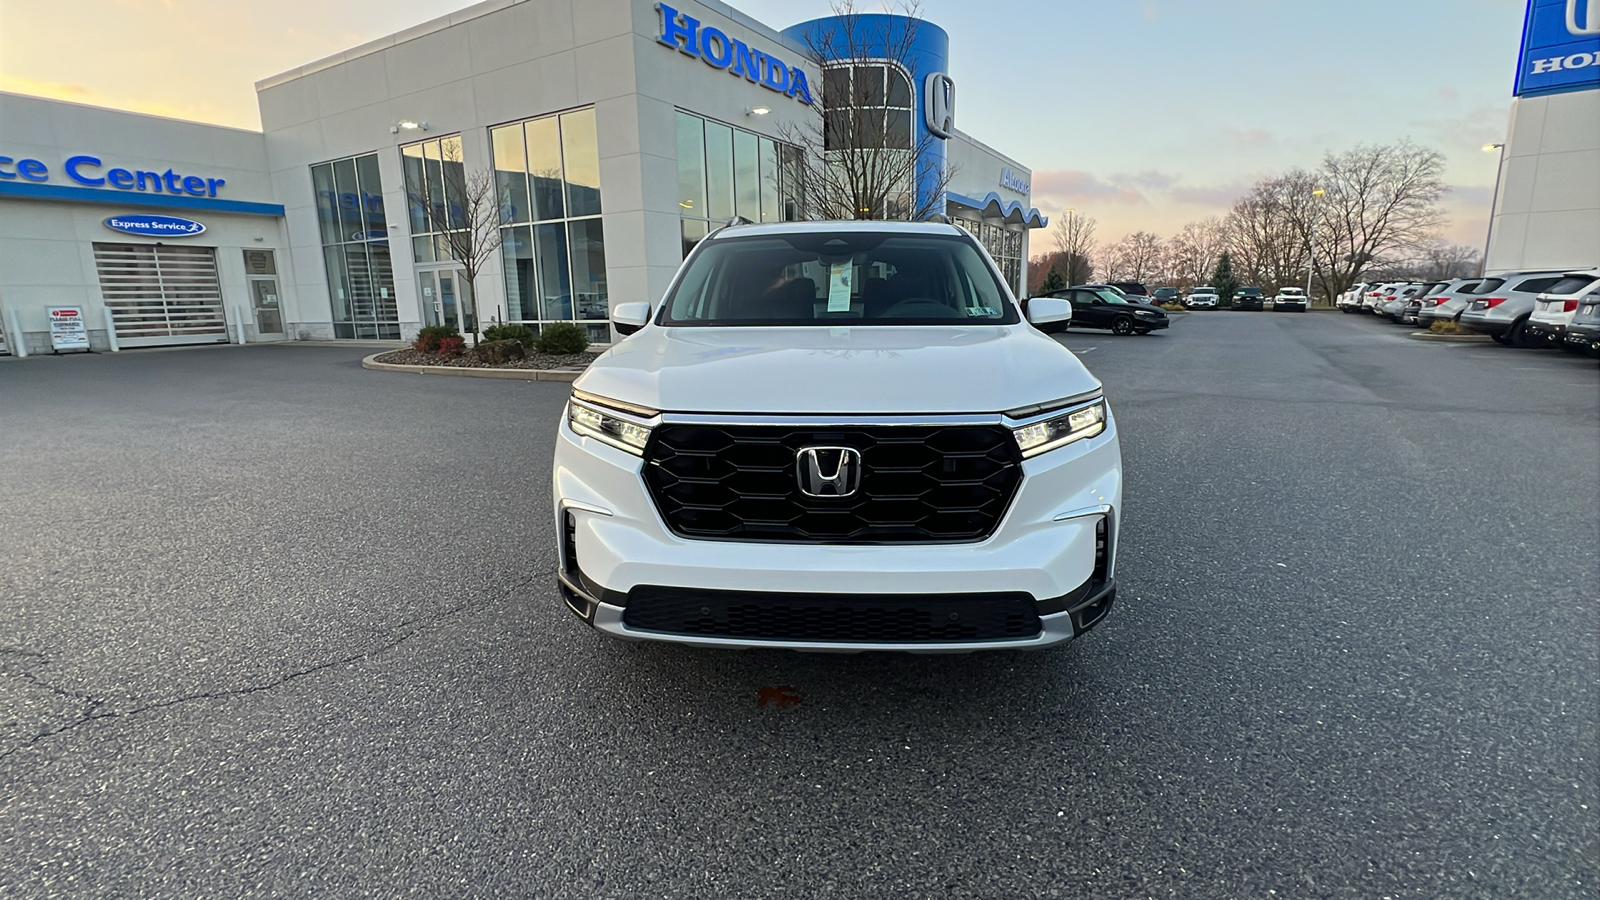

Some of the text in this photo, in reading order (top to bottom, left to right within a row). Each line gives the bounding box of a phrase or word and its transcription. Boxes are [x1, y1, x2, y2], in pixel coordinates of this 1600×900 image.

[656, 2, 813, 105] HONDA
[1530, 51, 1600, 75] HO
[64, 155, 226, 198] Center
[111, 219, 187, 231] Express Service
